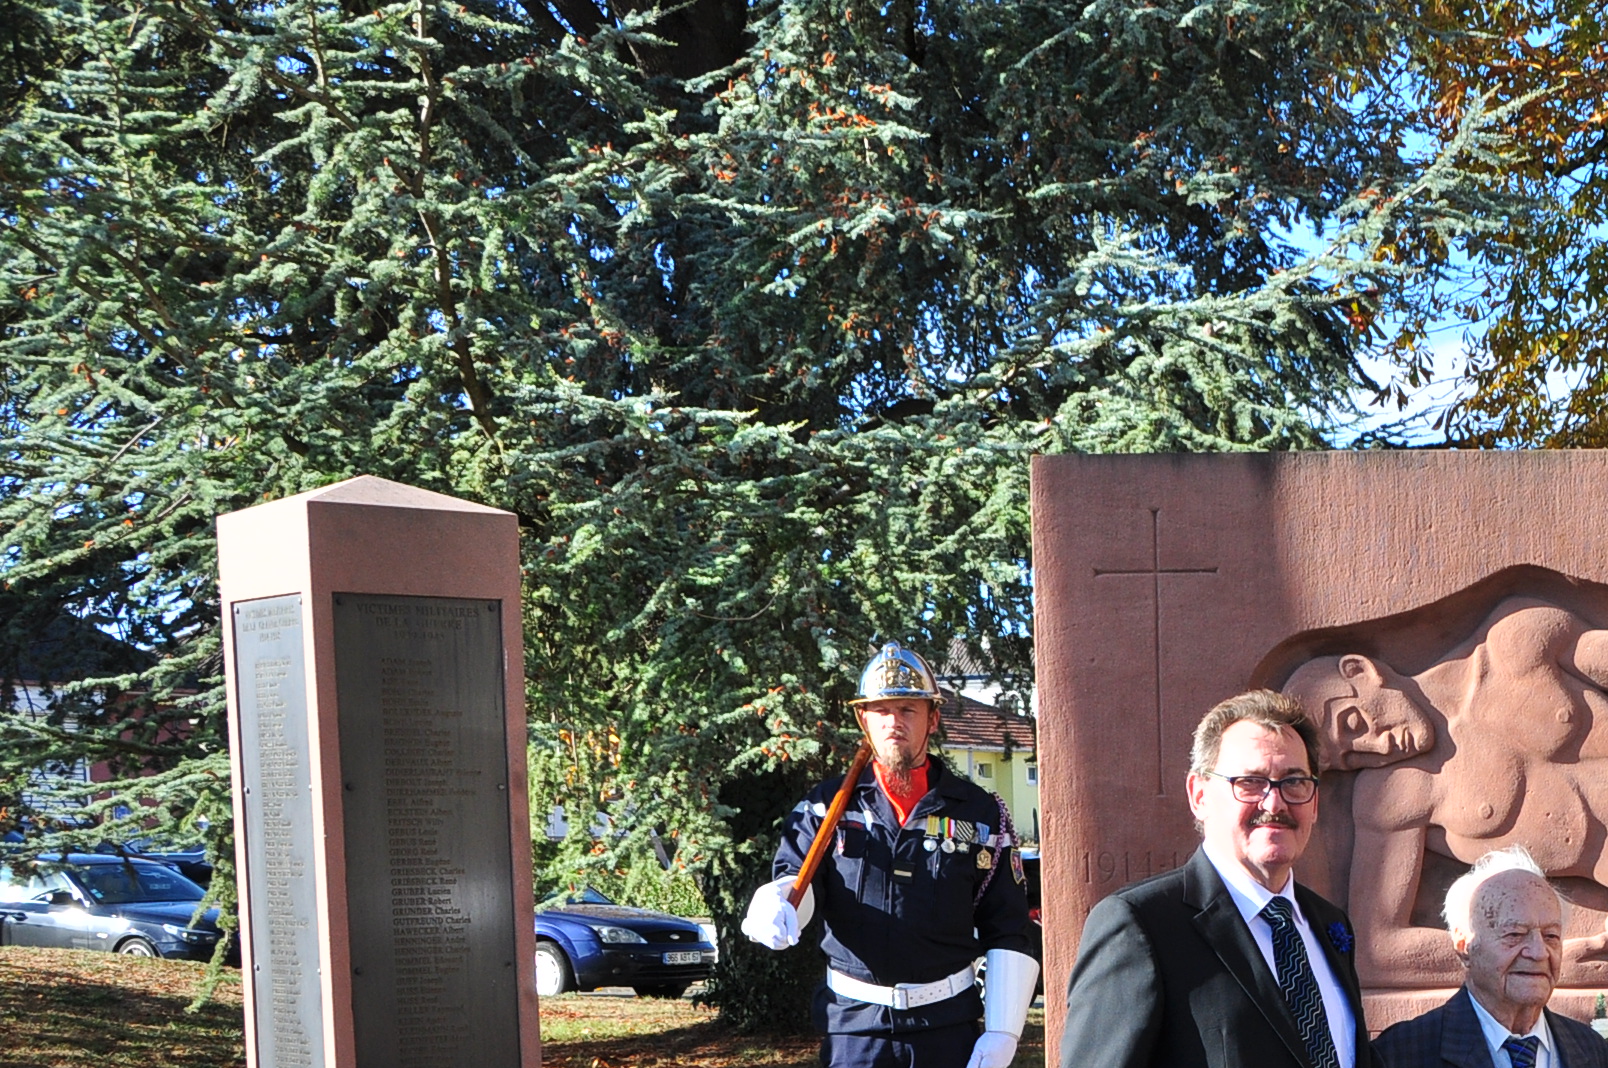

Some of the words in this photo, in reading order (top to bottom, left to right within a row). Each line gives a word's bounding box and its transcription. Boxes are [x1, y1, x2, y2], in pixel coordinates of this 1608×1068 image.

[357, 603, 410, 615] VICTIMES
[416, 605, 479, 618] MILITAIRES
[376, 617, 392, 627] DE
[1082, 851, 1193, 885] 1914-1
[392, 888, 426, 896] GRUBER
[392, 898, 426, 906] GRUBER
[428, 897, 452, 905] Robert
[392, 908, 432, 916] GRUNDER
[434, 907, 461, 915] Charles
[393, 918, 444, 926] GUTFREUND
